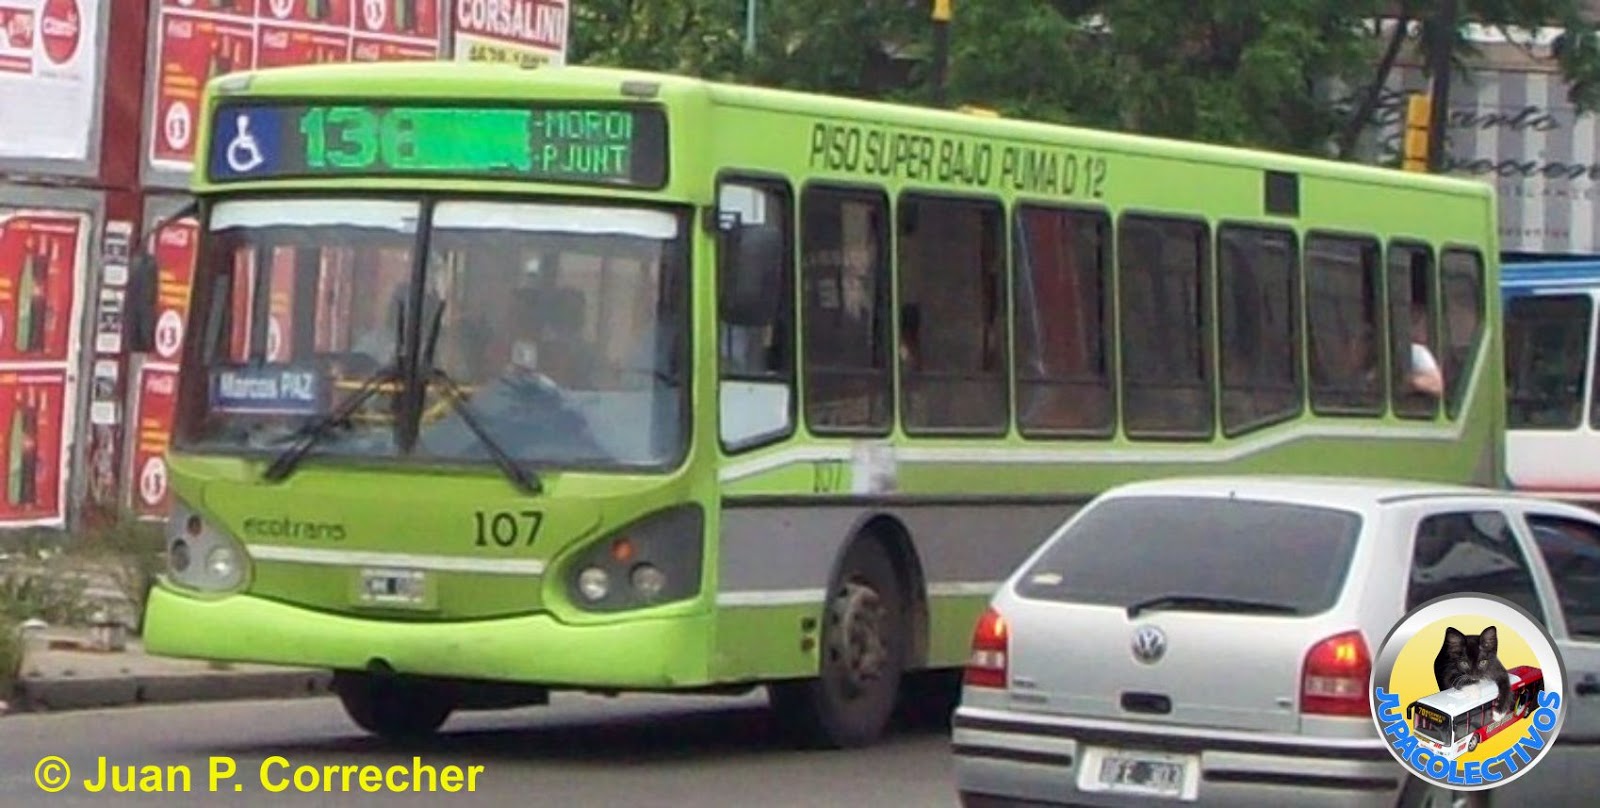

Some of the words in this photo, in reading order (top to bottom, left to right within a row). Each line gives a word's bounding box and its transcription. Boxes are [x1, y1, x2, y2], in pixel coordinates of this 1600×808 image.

[810, 122, 860, 171] PISO
[864, 130, 934, 181] SUPER
[939, 138, 993, 187] BAJO
[1000, 146, 1058, 195] PUMA
[1062, 153, 1078, 195] D
[1085, 155, 1107, 198] 12
[220, 373, 278, 399] Marcos
[281, 372, 313, 401] PAZ
[243, 515, 347, 541] ecotrans
[474, 510, 543, 547] 107
